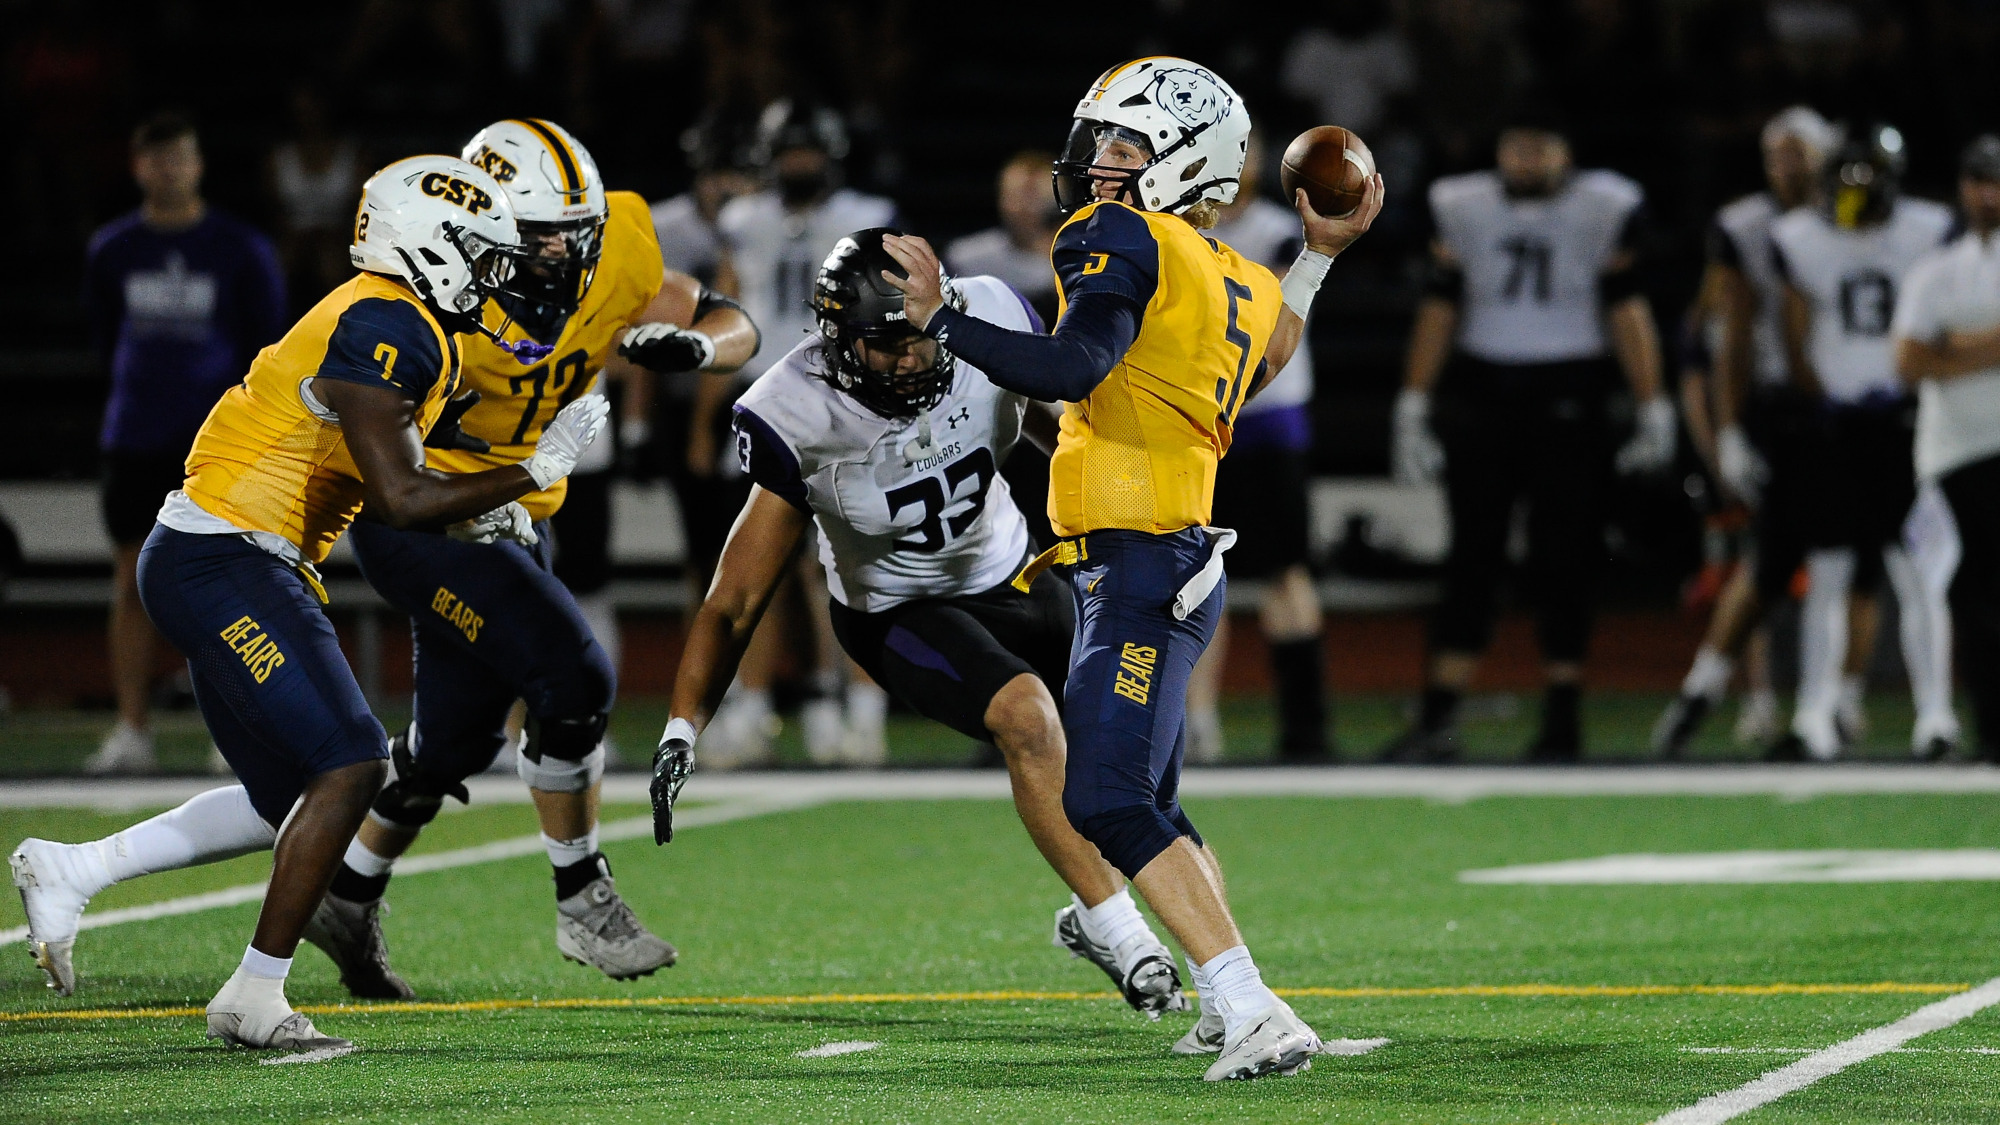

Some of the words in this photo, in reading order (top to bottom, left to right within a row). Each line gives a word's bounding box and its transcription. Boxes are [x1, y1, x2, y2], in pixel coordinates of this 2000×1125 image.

[421, 173, 492, 217] CSP
[1499, 234, 1555, 303] 71
[1215, 276, 1253, 426] 5
[732, 424, 752, 474] 3
[916, 441, 962, 472] COUGARS
[884, 446, 993, 553] 33
[430, 586, 484, 643] BEARS
[219, 615, 285, 684] BEARS
[1114, 642, 1158, 705] BEARS
